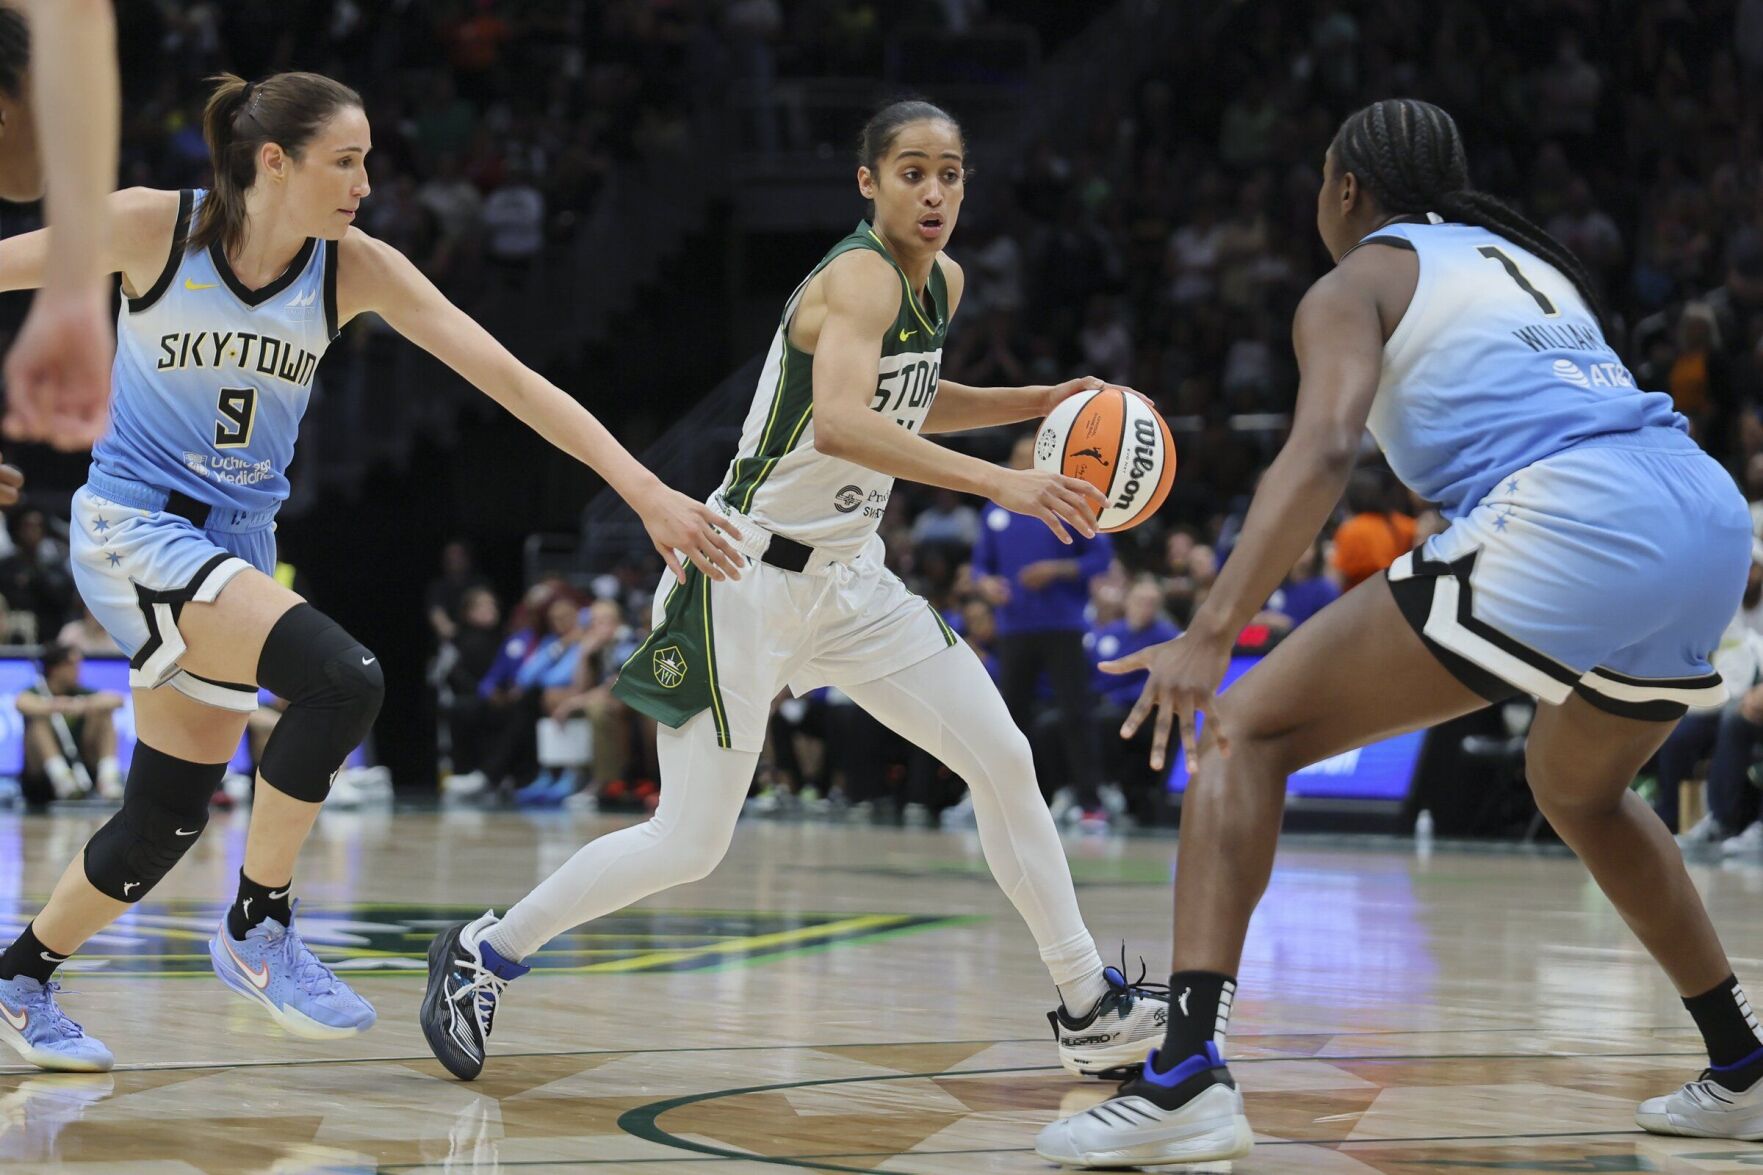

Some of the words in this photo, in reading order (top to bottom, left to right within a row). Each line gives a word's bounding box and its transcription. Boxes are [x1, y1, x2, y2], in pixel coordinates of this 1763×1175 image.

[1475, 245, 1559, 317] 1
[1511, 324, 1612, 352] WILLIAM
[215, 387, 258, 447] 9
[1114, 418, 1156, 510] Wilson
